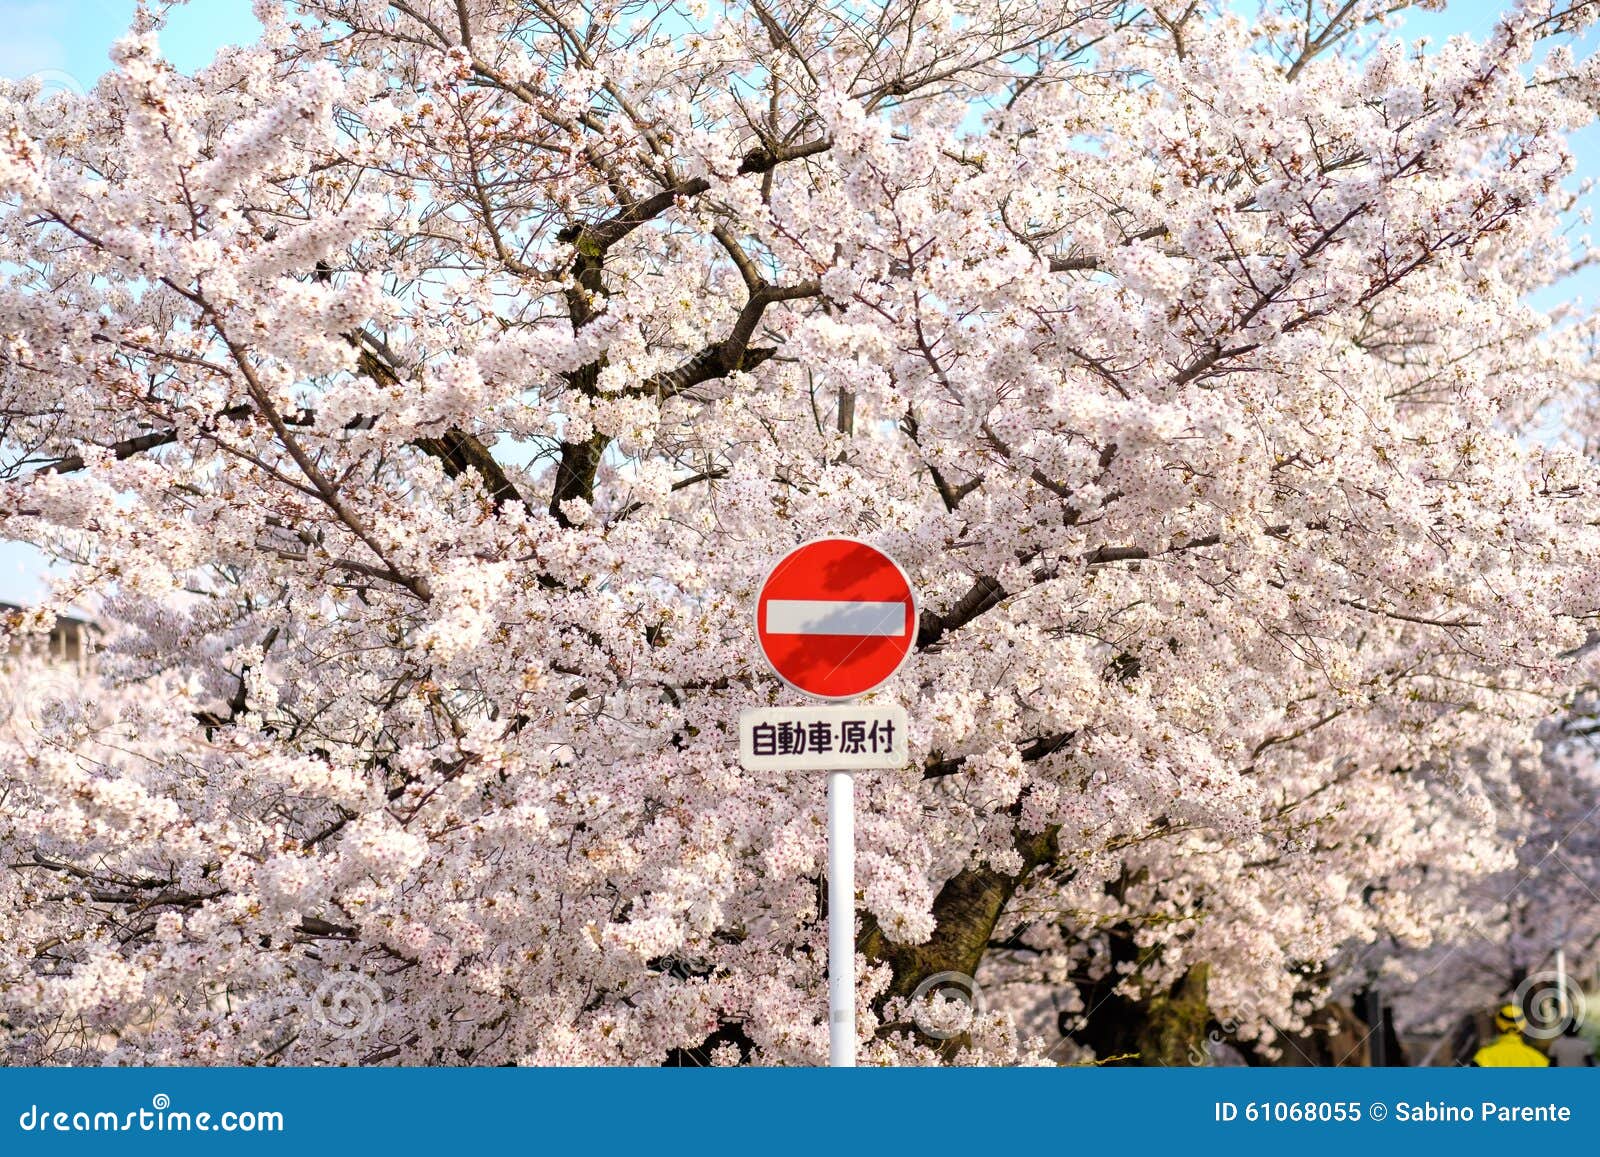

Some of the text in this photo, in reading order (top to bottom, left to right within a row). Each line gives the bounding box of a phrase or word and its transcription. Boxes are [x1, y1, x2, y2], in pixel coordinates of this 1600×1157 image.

[752, 719, 896, 757] 自動車・原付
